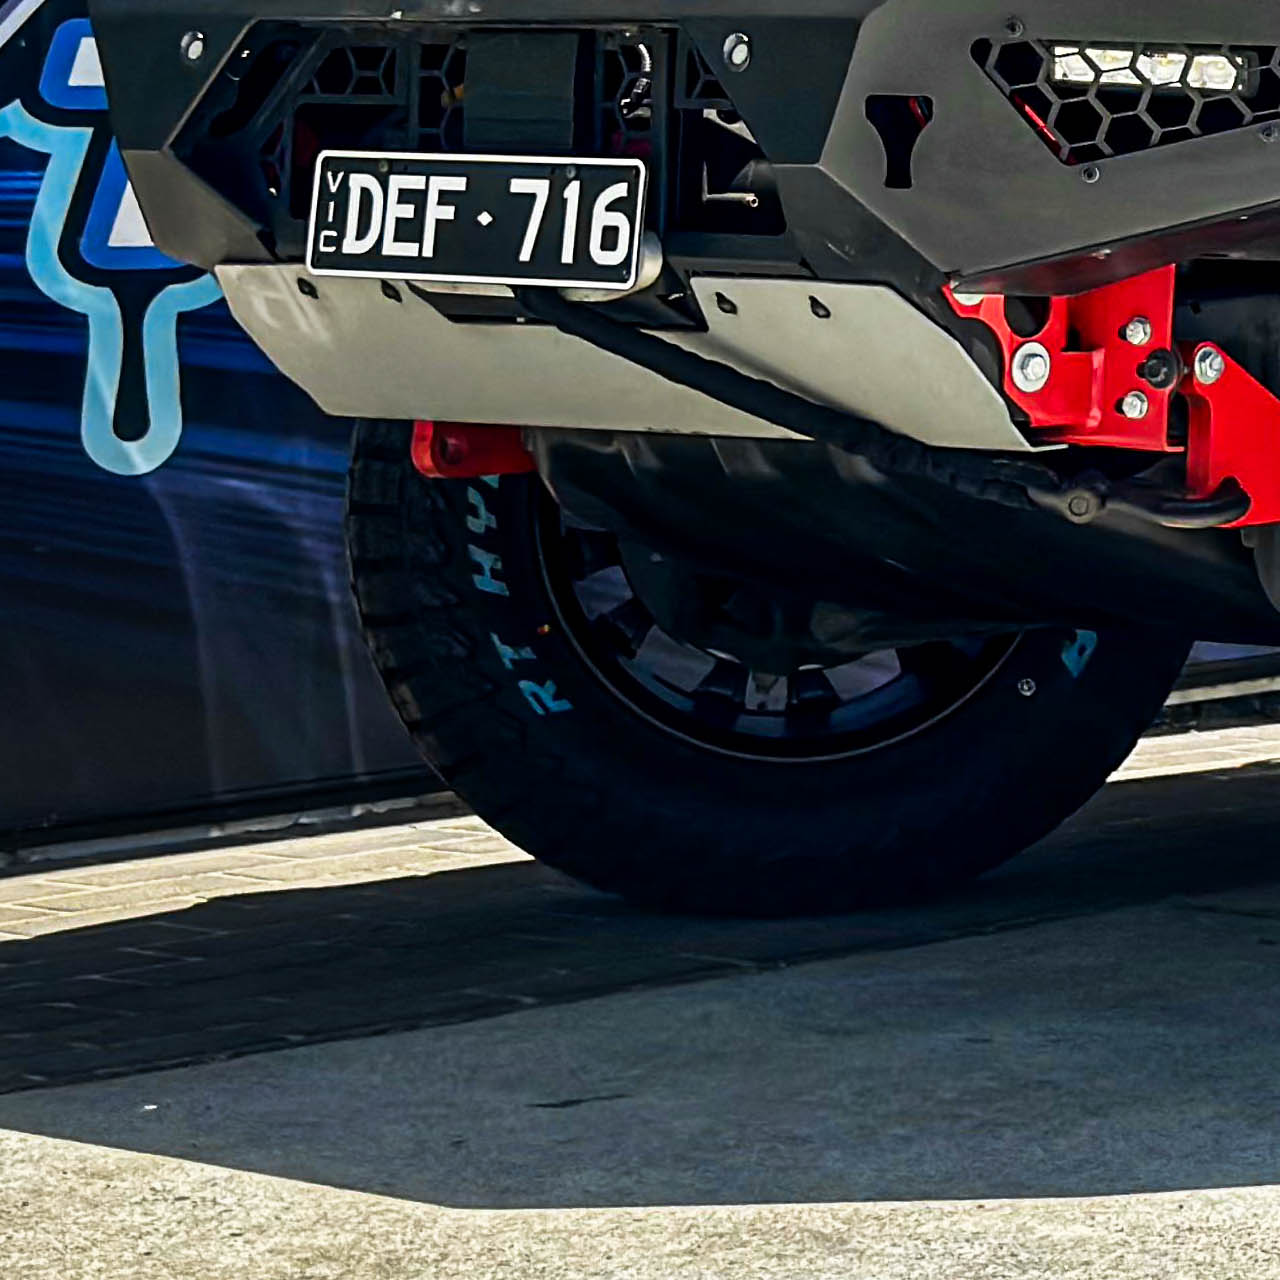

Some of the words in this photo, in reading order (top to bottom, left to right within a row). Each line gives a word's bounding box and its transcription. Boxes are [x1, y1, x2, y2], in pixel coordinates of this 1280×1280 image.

[319, 170, 345, 253] VIC
[341, 172, 468, 258] DEF
[509, 177, 631, 266] 716
